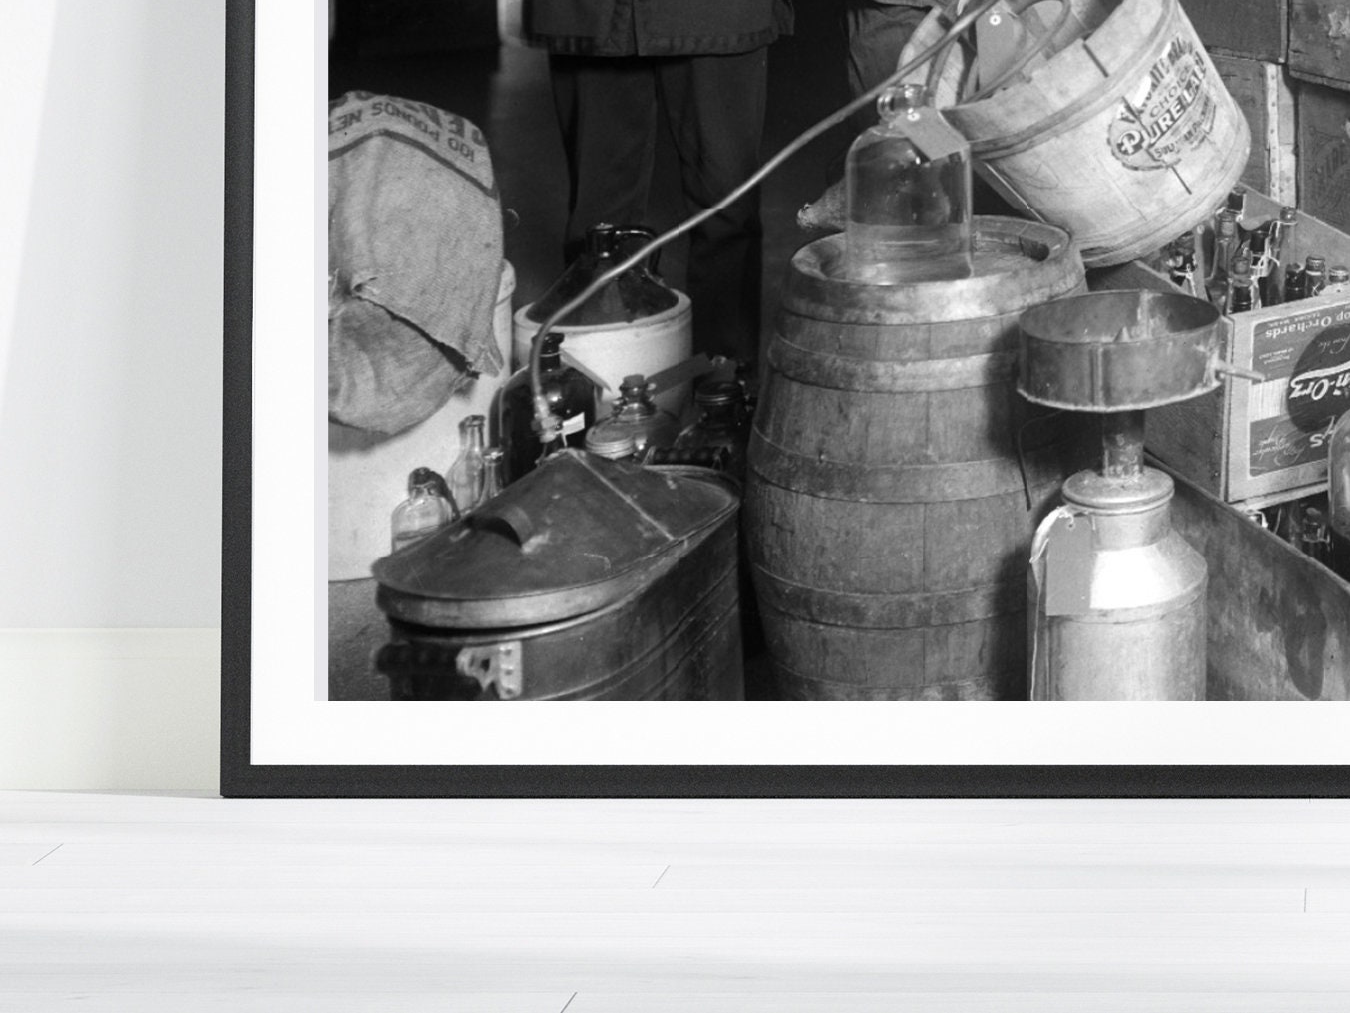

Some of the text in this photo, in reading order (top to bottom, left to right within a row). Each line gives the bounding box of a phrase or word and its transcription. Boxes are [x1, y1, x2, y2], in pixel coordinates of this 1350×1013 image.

[328, 108, 363, 136] NE
[1116, 99, 1182, 156] PURE
[447, 138, 475, 163] 100
[1264, 316, 1332, 340] Orchards
